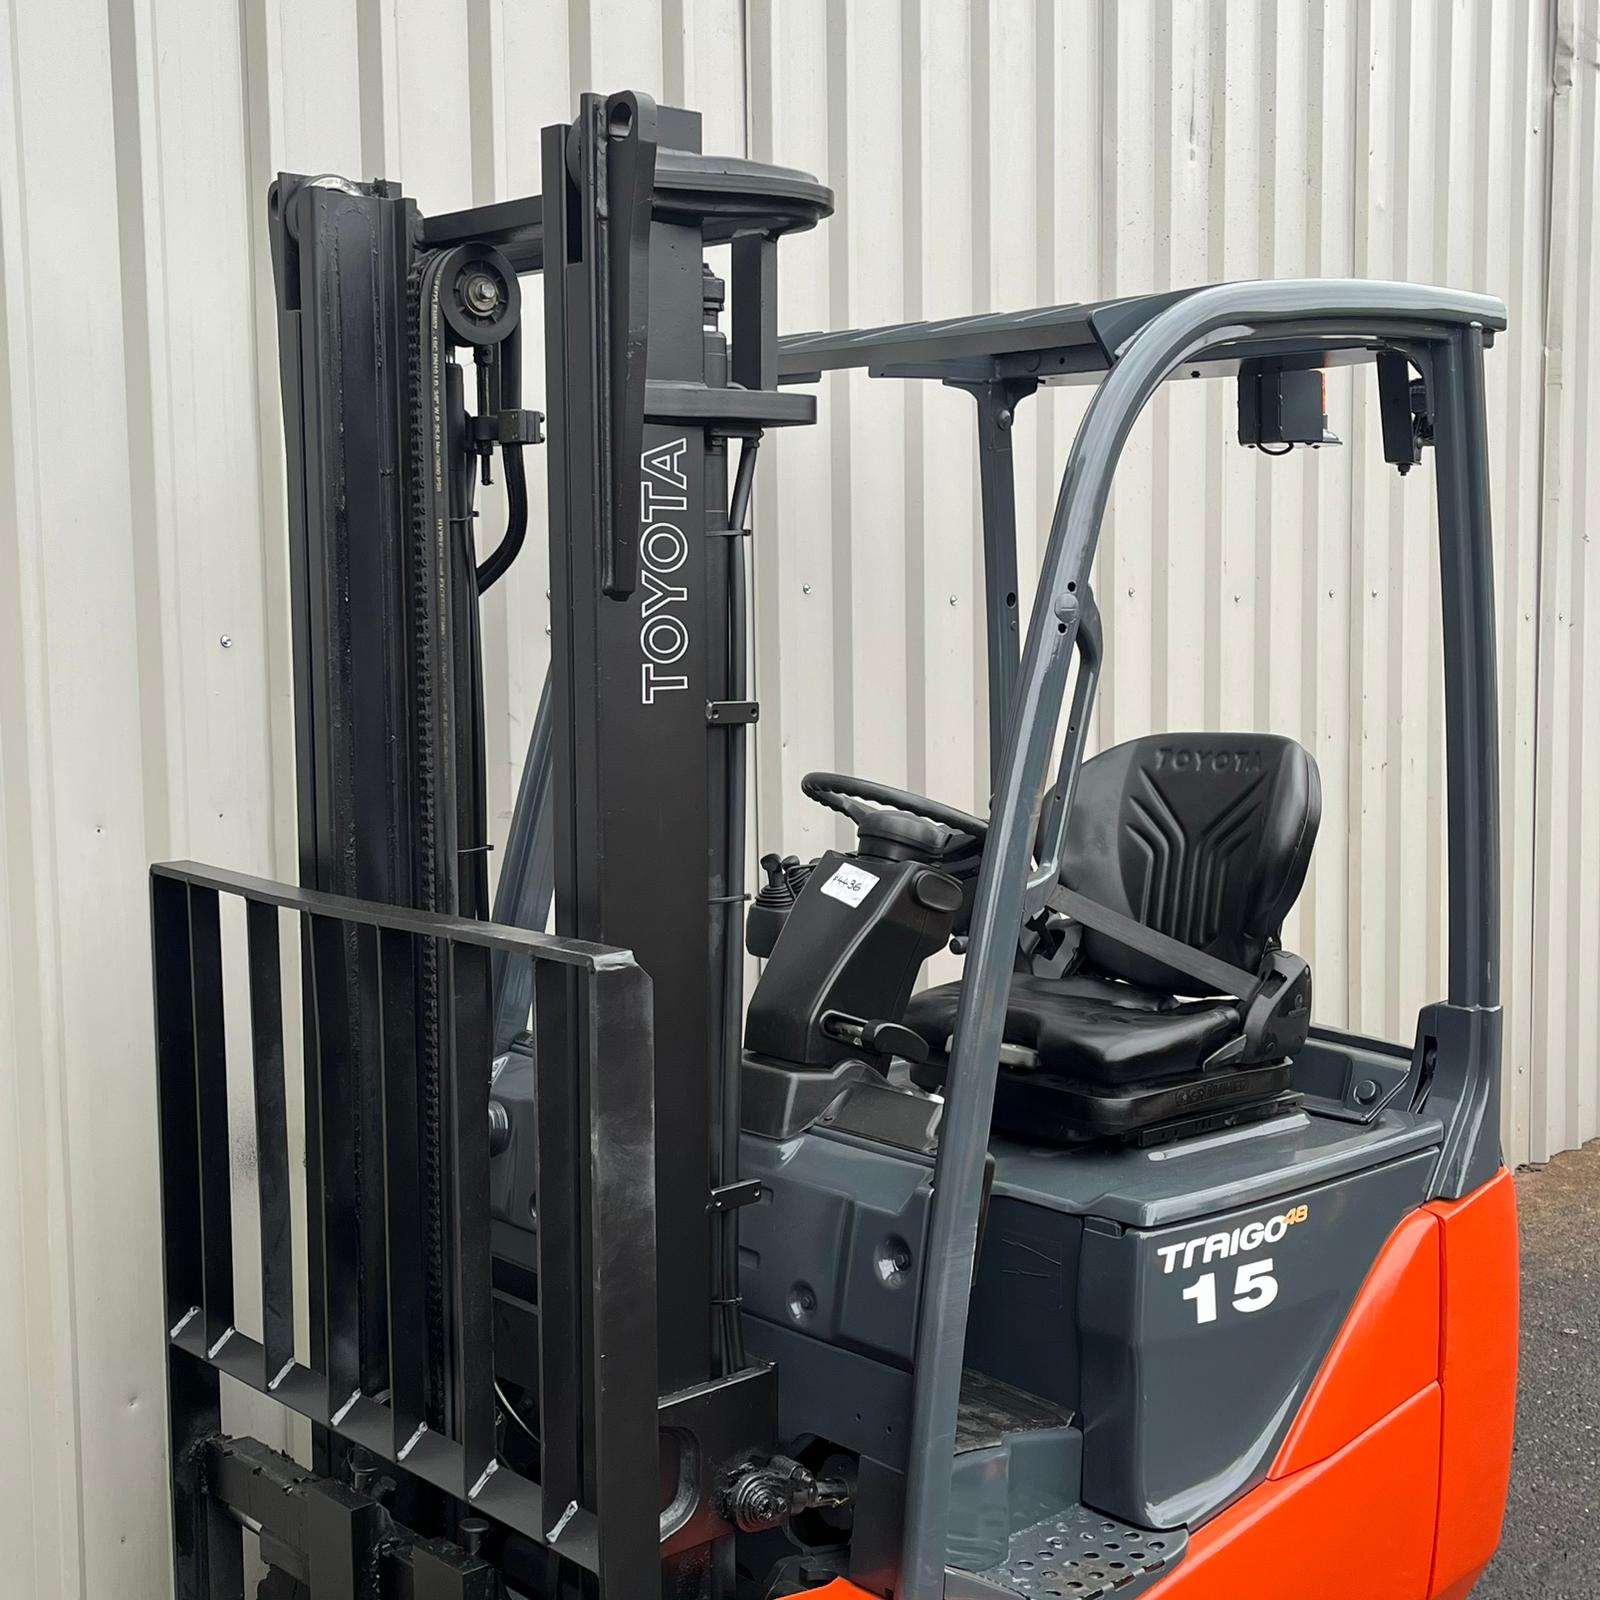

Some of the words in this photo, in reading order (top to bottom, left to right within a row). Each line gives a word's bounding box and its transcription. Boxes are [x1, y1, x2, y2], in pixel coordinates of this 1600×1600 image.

[640, 437, 689, 705] TOYOTA
[1154, 748, 1261, 773] TOYOTA
[1282, 1204, 1309, 1226] 48
